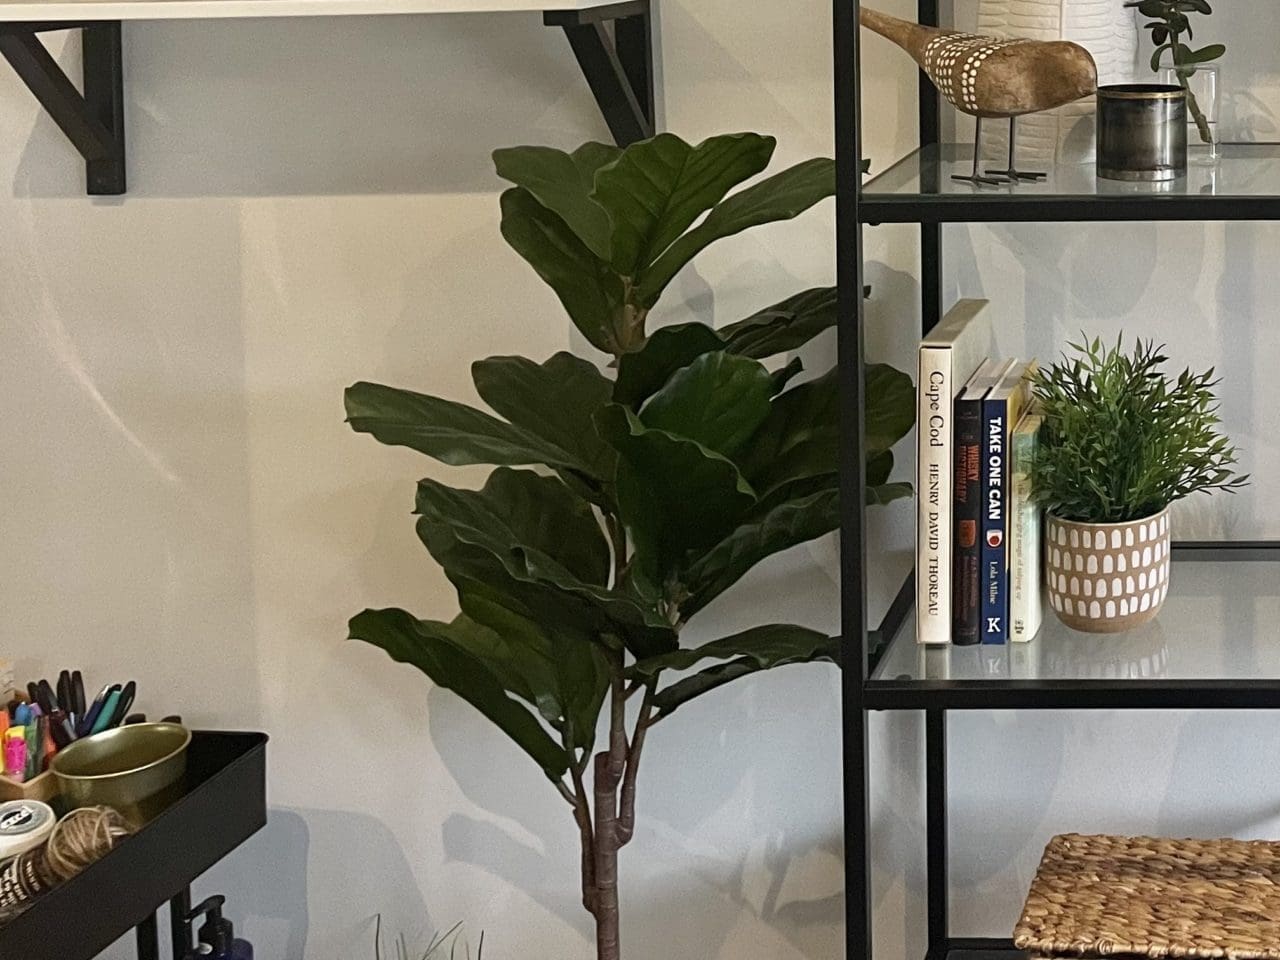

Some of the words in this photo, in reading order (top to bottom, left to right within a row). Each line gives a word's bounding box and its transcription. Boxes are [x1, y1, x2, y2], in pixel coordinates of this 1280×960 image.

[925, 371, 944, 411] Cape
[929, 415, 944, 447] Cod
[989, 417, 1002, 453] TAKE
[967, 444, 979, 481] WHISKY
[989, 455, 1002, 487] ONE
[929, 464, 939, 505] HENRY
[988, 489, 1001, 520] CAN
[929, 512, 939, 550] DAVID
[928, 556, 939, 616] THOREAU
[989, 561, 999, 578] Lola
